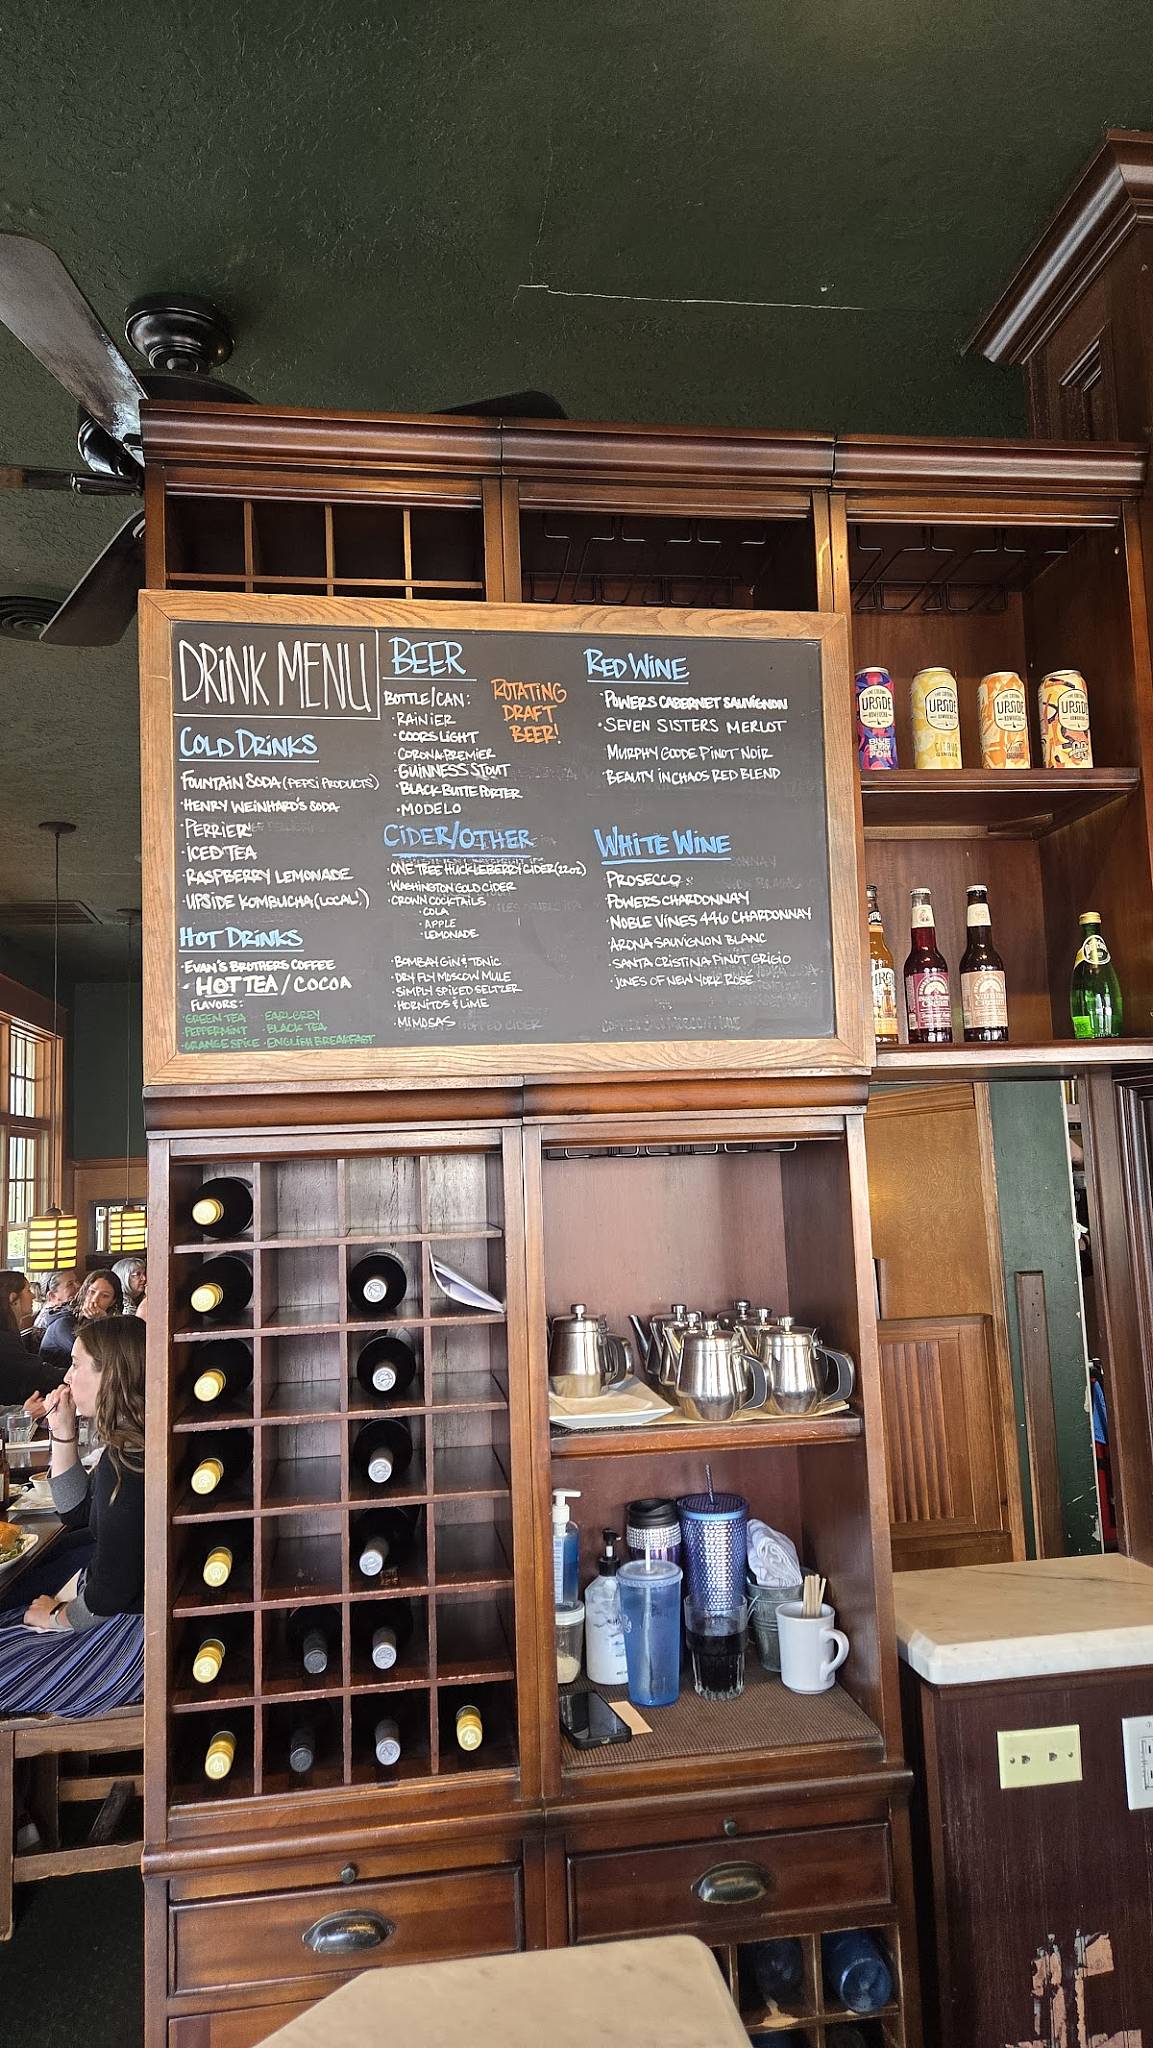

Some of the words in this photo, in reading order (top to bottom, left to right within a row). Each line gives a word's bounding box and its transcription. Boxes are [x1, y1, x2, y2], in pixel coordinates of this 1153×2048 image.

[389, 637, 466, 676] BEER
[584, 649, 627, 679] RED
[628, 653, 690, 681] WINE
[180, 640, 270, 706] DRINK
[278, 640, 371, 712] MENU
[384, 687, 470, 707] BOTTLE/CAN:
[491, 679, 566, 703] ROTATING
[604, 690, 657, 710] POWERS
[659, 697, 721, 710] CABERNET
[723, 695, 788, 709] SAUVIGNON
[862, 696, 892, 711] UPSIDE
[397, 712, 456, 726] RAINIER
[502, 705, 557, 722] DRAFT
[604, 717, 650, 732] SEVEN
[657, 719, 719, 732] SISTERS
[726, 720, 787, 733] MERLOT
[399, 731, 438, 742] COORS
[440, 731, 479, 743] LIGHT
[510, 724, 561, 744] BEER!
[180, 727, 234, 757] COLD
[235, 729, 318, 758] DRINKS
[398, 749, 441, 760] CORONA
[443, 748, 496, 760] PREMIER
[607, 744, 658, 760] MURPHY
[661, 747, 698, 759] GOODE
[699, 746, 739, 760] PINOT
[740, 745, 773, 760] NOIR
[398, 764, 468, 778] GUINNESS
[470, 764, 511, 777] STOUT
[606, 770, 654, 785] BEAUTY
[672, 770, 710, 784] CHAOS
[712, 770, 738, 782] RED
[740, 768, 780, 780] BLEND
[182, 770, 243, 790] FOUNTAIN
[246, 774, 282, 788] SODA
[283, 776, 319, 790] (PEPSI
[322, 773, 379, 790] PRODUCTS)
[399, 782, 441, 797] BLACK
[442, 785, 479, 797] BUTTE
[479, 785, 523, 799] PORTER
[184, 799, 227, 812] HENRY
[231, 797, 307, 813] WEINHARD'S
[310, 801, 340, 812] SODA
[401, 803, 461, 816] MODELO
[185, 818, 252, 838] PERRIER
[383, 821, 534, 849] CIDER/OTHER
[594, 826, 670, 857] WHITE
[672, 830, 731, 855] WINE
[186, 843, 222, 862] ICED
[222, 845, 257, 862] TEA
[186, 868, 270, 885] RASPBERRY
[275, 868, 354, 883] LEMONADE
[391, 863, 414, 875] ONE
[415, 865, 442, 876] TREE
[444, 864, 522, 876] HUCKLEBERRY
[523, 863, 554, 874] CIDER
[391, 880, 454, 892] WASHINGTON
[456, 883, 481, 893] GOLD
[482, 881, 517, 892] CIDER
[606, 871, 681, 888] PROSECCO
[186, 892, 235, 909] UPSIDE
[239, 894, 313, 910] KOMBUCHA
[391, 896, 427, 905] CROWN
[428, 896, 487, 906] COCKTAILS
[607, 894, 660, 909] POWERS
[662, 891, 749, 905] CHARDONNAY
[423, 908, 449, 916] COLA
[610, 915, 652, 930] NOBLE
[655, 915, 698, 928] VINES
[700, 912, 728, 926] 446
[731, 907, 811, 923] CHARDONNAY
[425, 919, 456, 928] APPLE
[179, 928, 223, 948] HOT
[225, 927, 303, 948] DRINKS
[425, 929, 479, 939] LEMONADE
[610, 938, 653, 952] ARONA
[654, 934, 722, 947] SAUVIGNON
[724, 933, 767, 944] BLANC
[185, 959, 228, 974] EVAN'S
[230, 961, 289, 972] BROTHERS
[291, 959, 336, 971] COFFEE
[394, 956, 438, 968] BOMBAY
[440, 956, 460, 966] GIN
[469, 956, 501, 966] TONIC
[612, 959, 654, 969] SANTA
[655, 955, 710, 968] CRISTINA
[712, 953, 751, 964] PINOT
[751, 952, 791, 964] GRIGIO
[196, 976, 242, 996] HOT
[244, 974, 278, 993] TEA
[294, 976, 352, 992] COCOA
[395, 973, 415, 984] DRY
[417, 973, 436, 983] FLY
[437, 971, 479, 983] MOSCOW
[482, 971, 511, 982] MULE
[614, 974, 647, 989] JONES
[650, 974, 665, 986] OF
[666, 974, 693, 986] NEW
[694, 975, 723, 986] YORK
[396, 986, 432, 996] SIMPLY
[436, 985, 473, 995] SPIKED
[474, 984, 523, 994] SELTZER
[191, 999, 244, 1011] FLAVORS:
[397, 999, 450, 1011] HORNITOS
[460, 998, 489, 1008] LIME
[185, 1014, 222, 1023] GREEN
[224, 1013, 246, 1022] TEA
[265, 1011, 290, 1020] EARL
[290, 1011, 320, 1023] GREY
[398, 1017, 456, 1028] MIMOSAS
[185, 1026, 247, 1037] PEPPERMINT
[267, 1025, 302, 1033] BLACK
[306, 1023, 327, 1031] TEA
[185, 1041, 228, 1050] ORANGE
[231, 1038, 260, 1048] SPICE
[267, 1037, 312, 1049] ENGLISH
[313, 1034, 375, 1045] BREAKFAST
